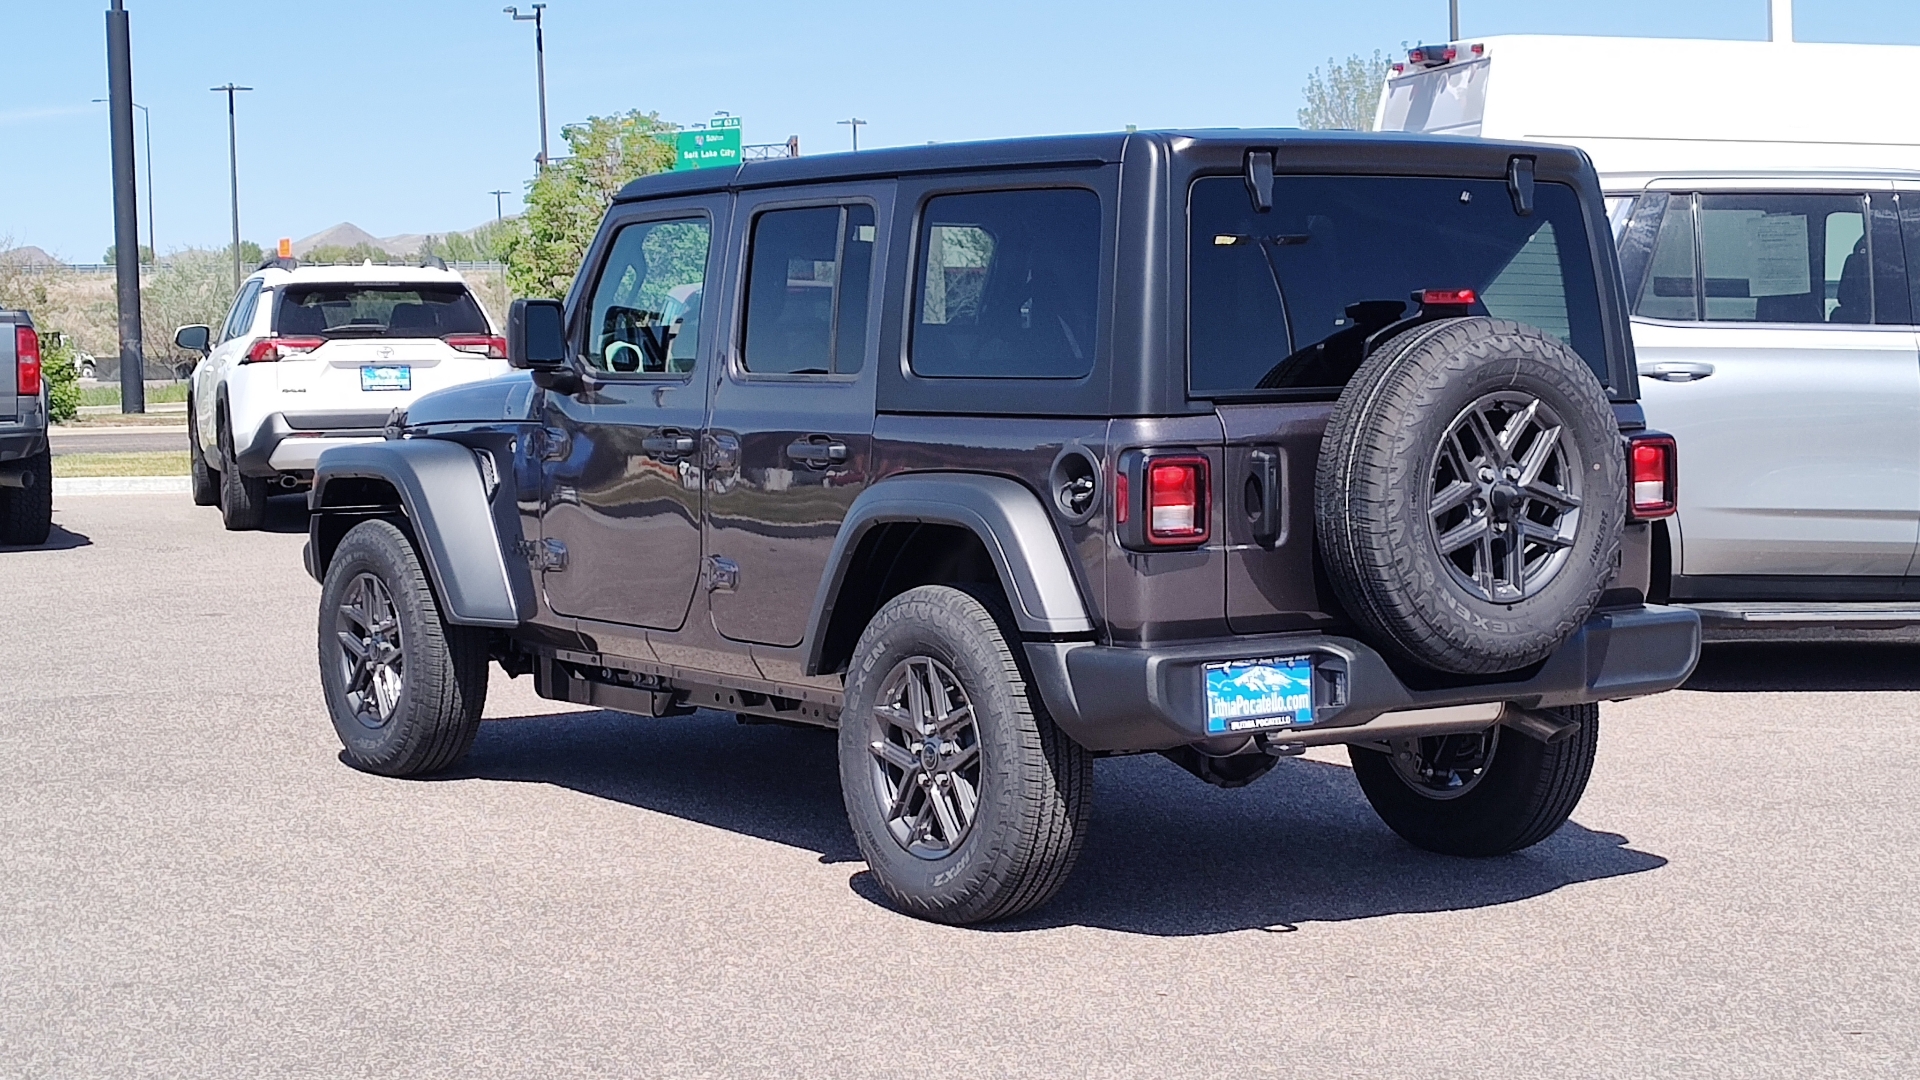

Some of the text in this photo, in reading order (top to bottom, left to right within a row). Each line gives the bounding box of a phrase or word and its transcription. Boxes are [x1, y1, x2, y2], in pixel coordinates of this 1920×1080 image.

[684, 148, 736, 159] Salt Lake City
[1440, 588, 1518, 632] NEXEN
[1208, 692, 1309, 718] LithiaPocatello.com
